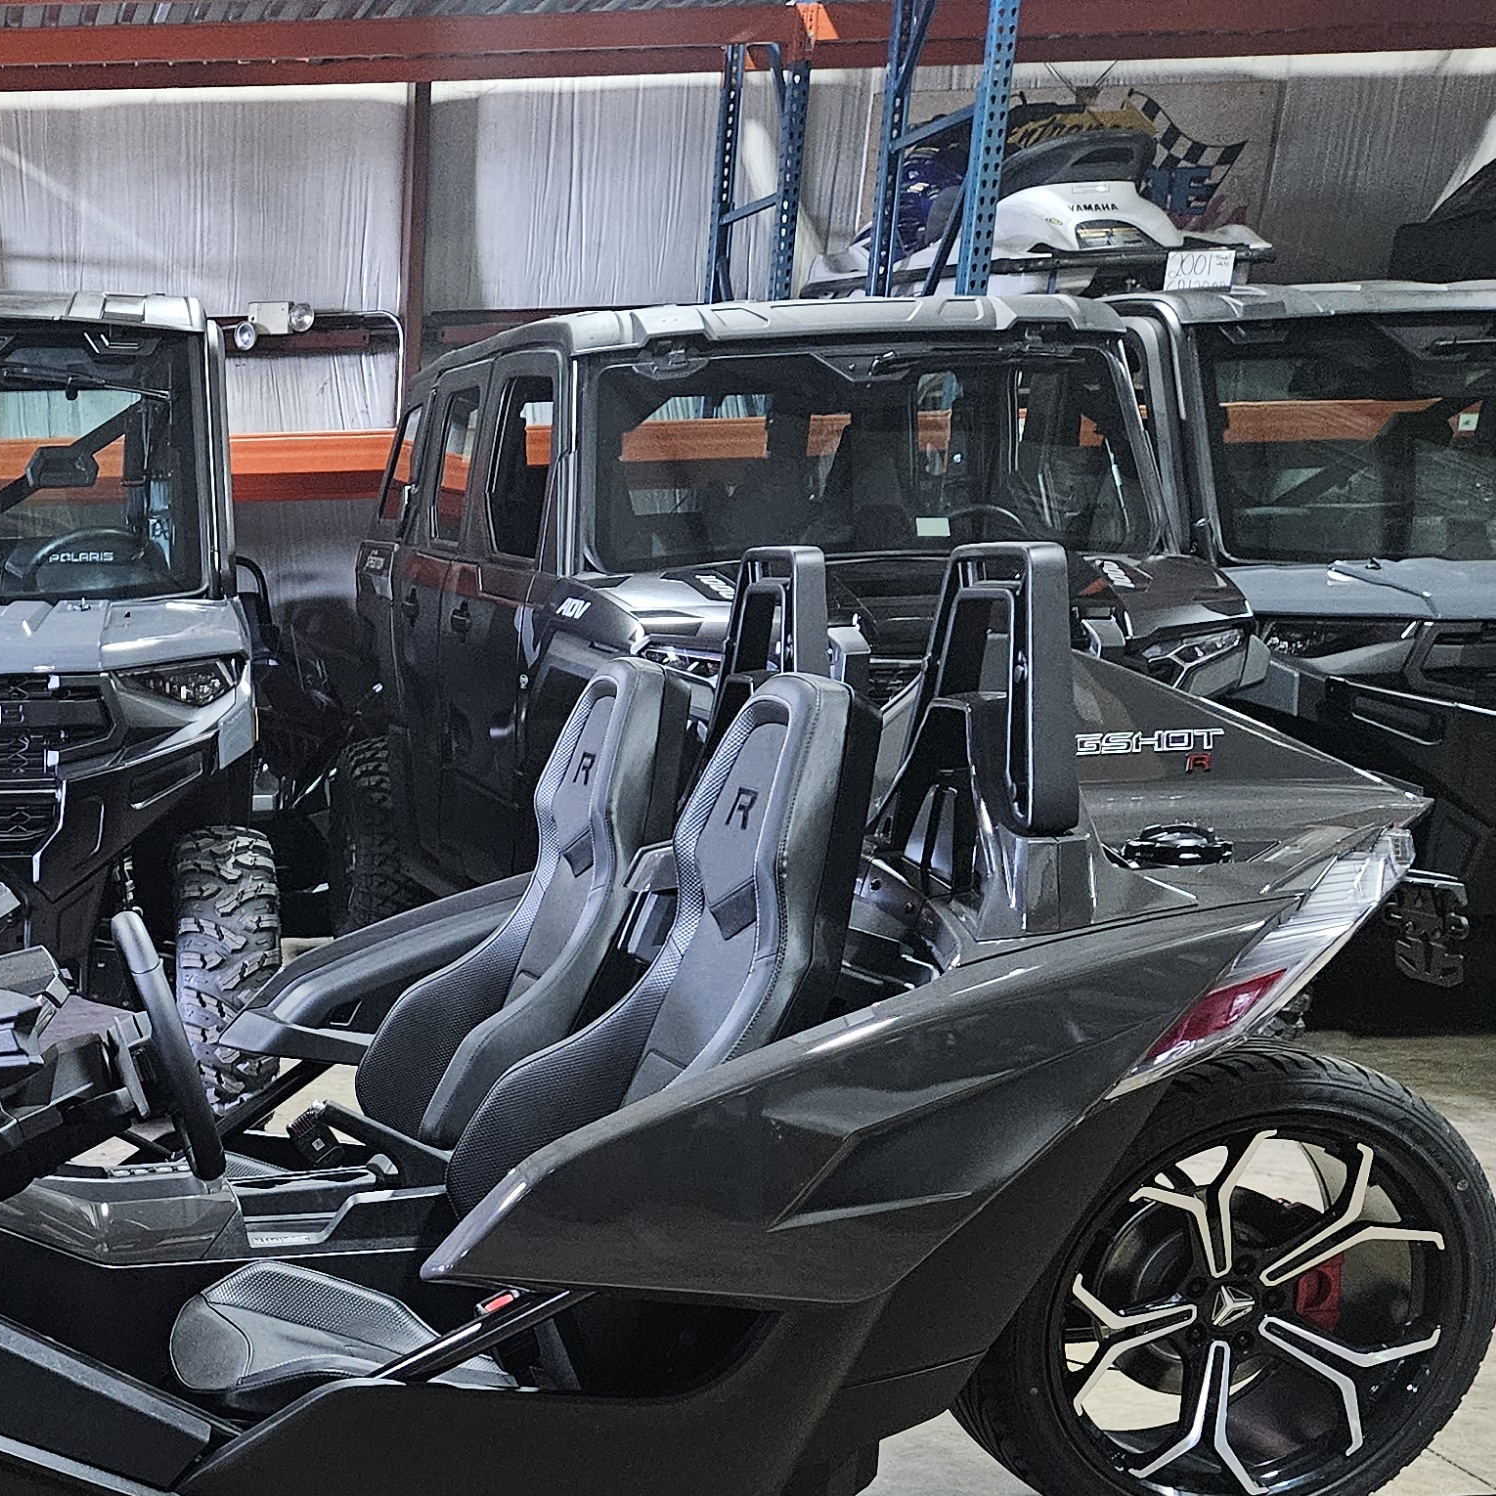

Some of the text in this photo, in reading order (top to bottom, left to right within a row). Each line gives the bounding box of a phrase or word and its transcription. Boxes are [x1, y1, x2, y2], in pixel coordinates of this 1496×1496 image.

[1067, 203, 1119, 213] YAMAHA
[1167, 252, 1213, 279] 2001
[48, 551, 114, 563] POLARIS
[555, 597, 592, 620] ADV
[573, 752, 596, 785] R
[1185, 752, 1212, 773] R
[725, 788, 758, 829] R
